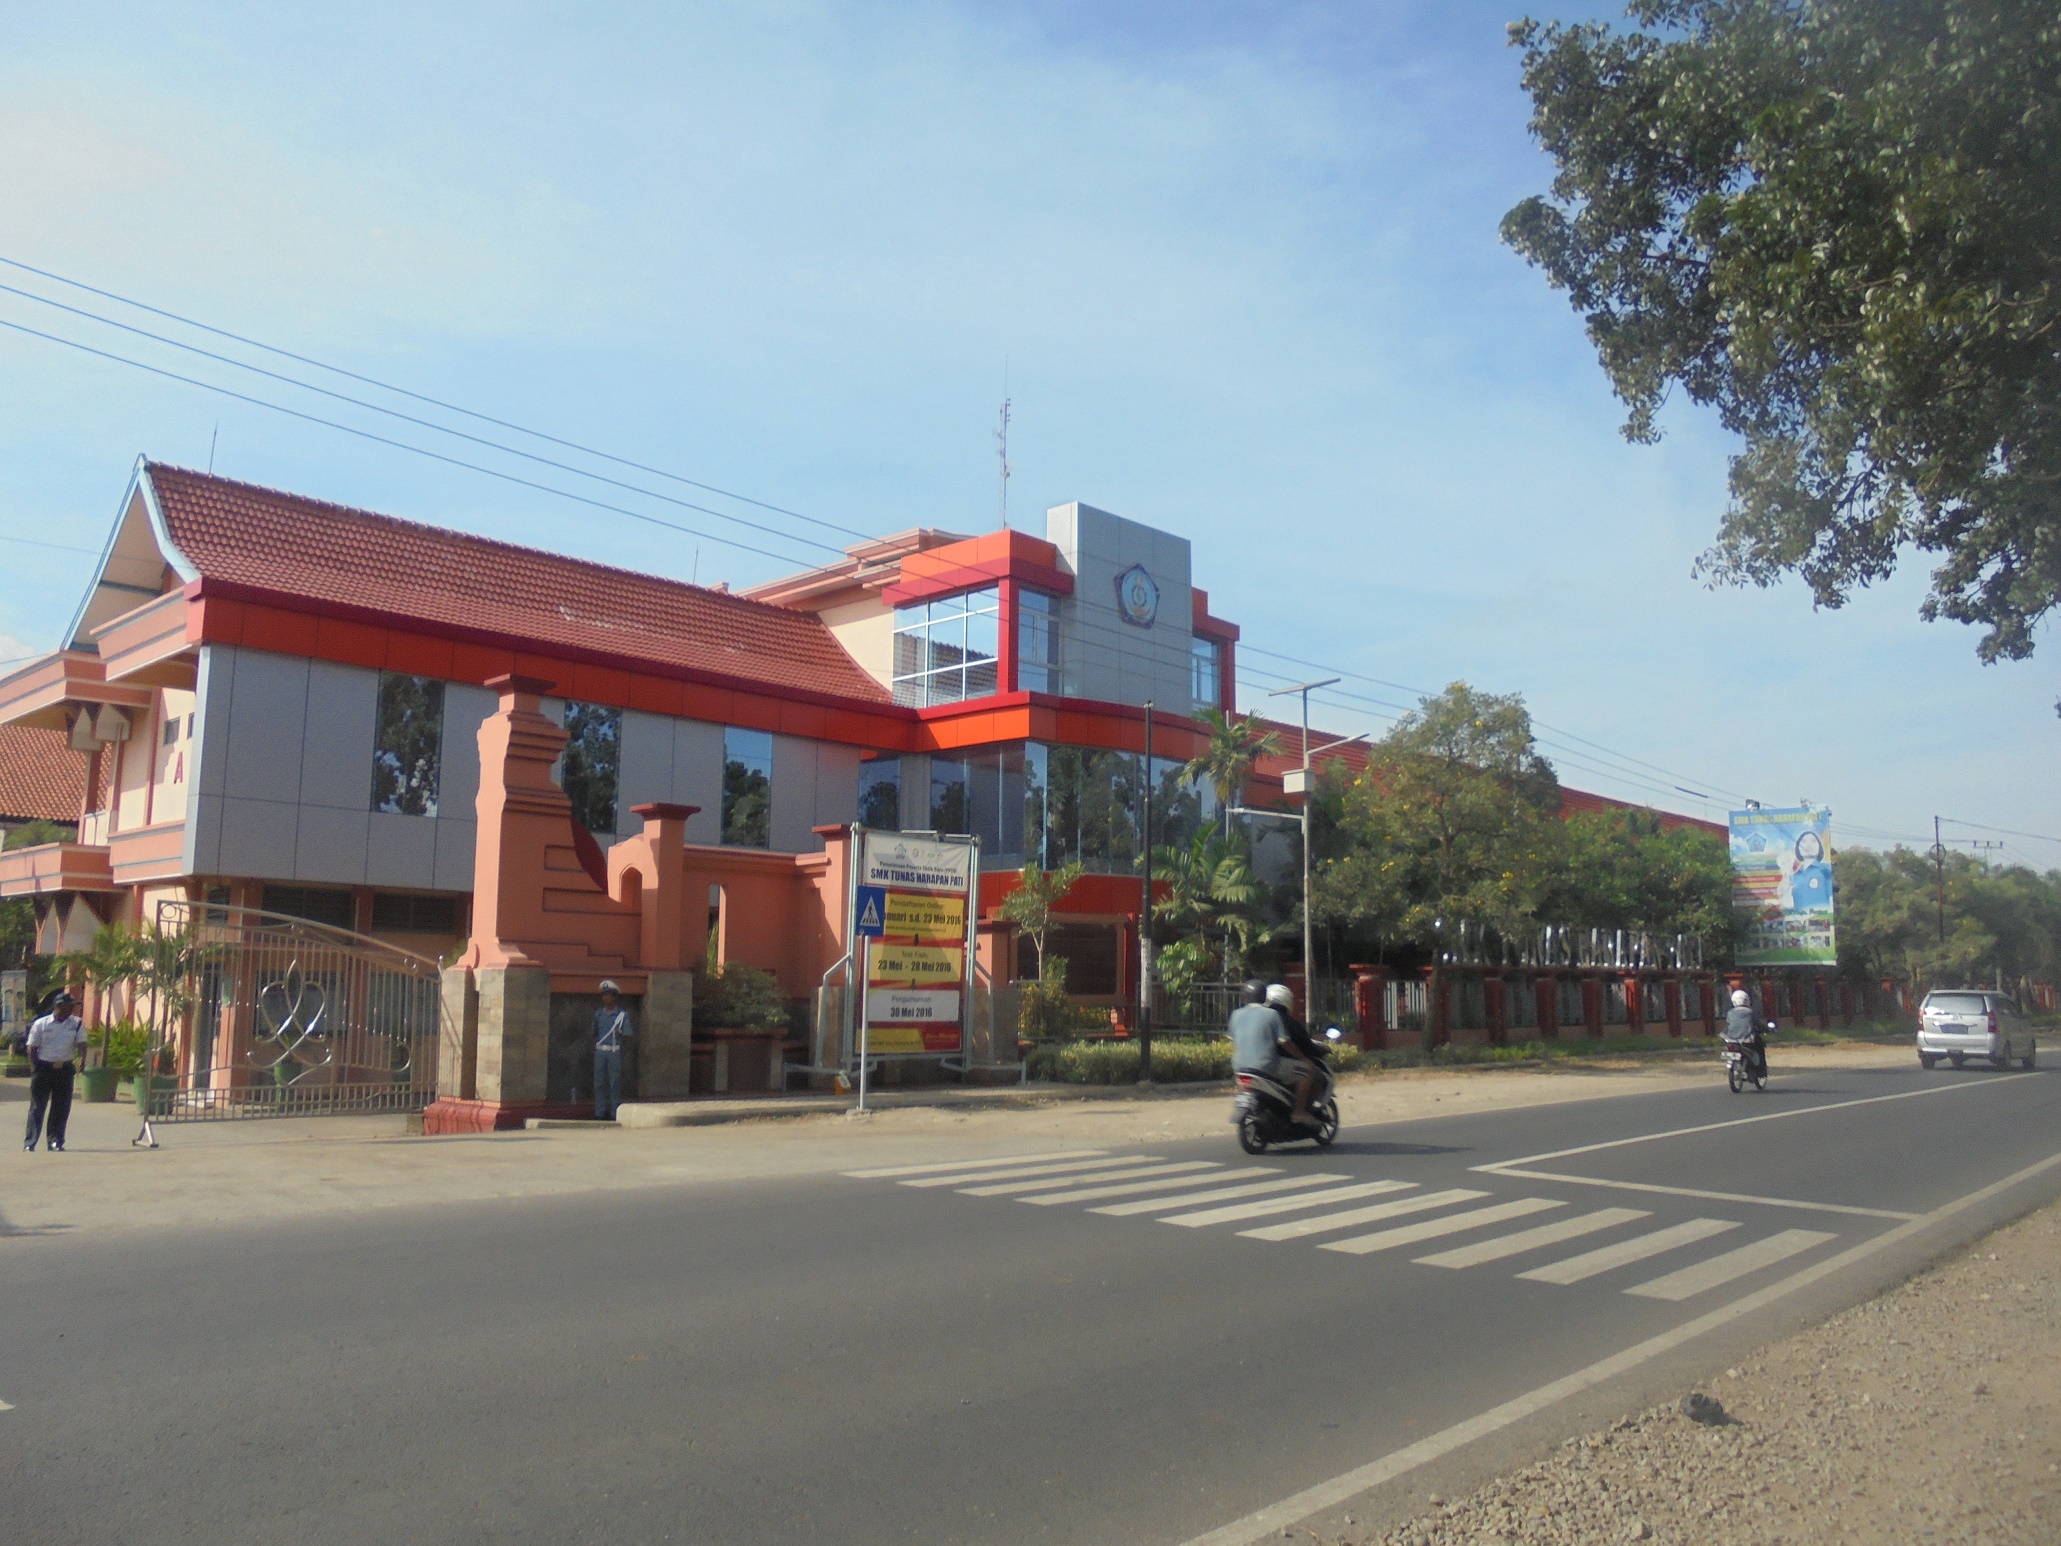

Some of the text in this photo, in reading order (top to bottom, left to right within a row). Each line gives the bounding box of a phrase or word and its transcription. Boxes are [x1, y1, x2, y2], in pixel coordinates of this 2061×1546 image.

[870, 868, 964, 887] SMK TUNAS HARAPAN PATI
[890, 899, 925, 908] Pendaftaran
[923, 913, 933, 925] 23
[933, 914, 946, 924] Mei
[946, 915, 961, 925] 2016
[877, 960, 888, 970] 23
[888, 960, 903, 970] Mei
[922, 962, 934, 971] Mei
[935, 962, 952, 972] 2016
[890, 1007, 933, 1017] 30 Mei 2016
